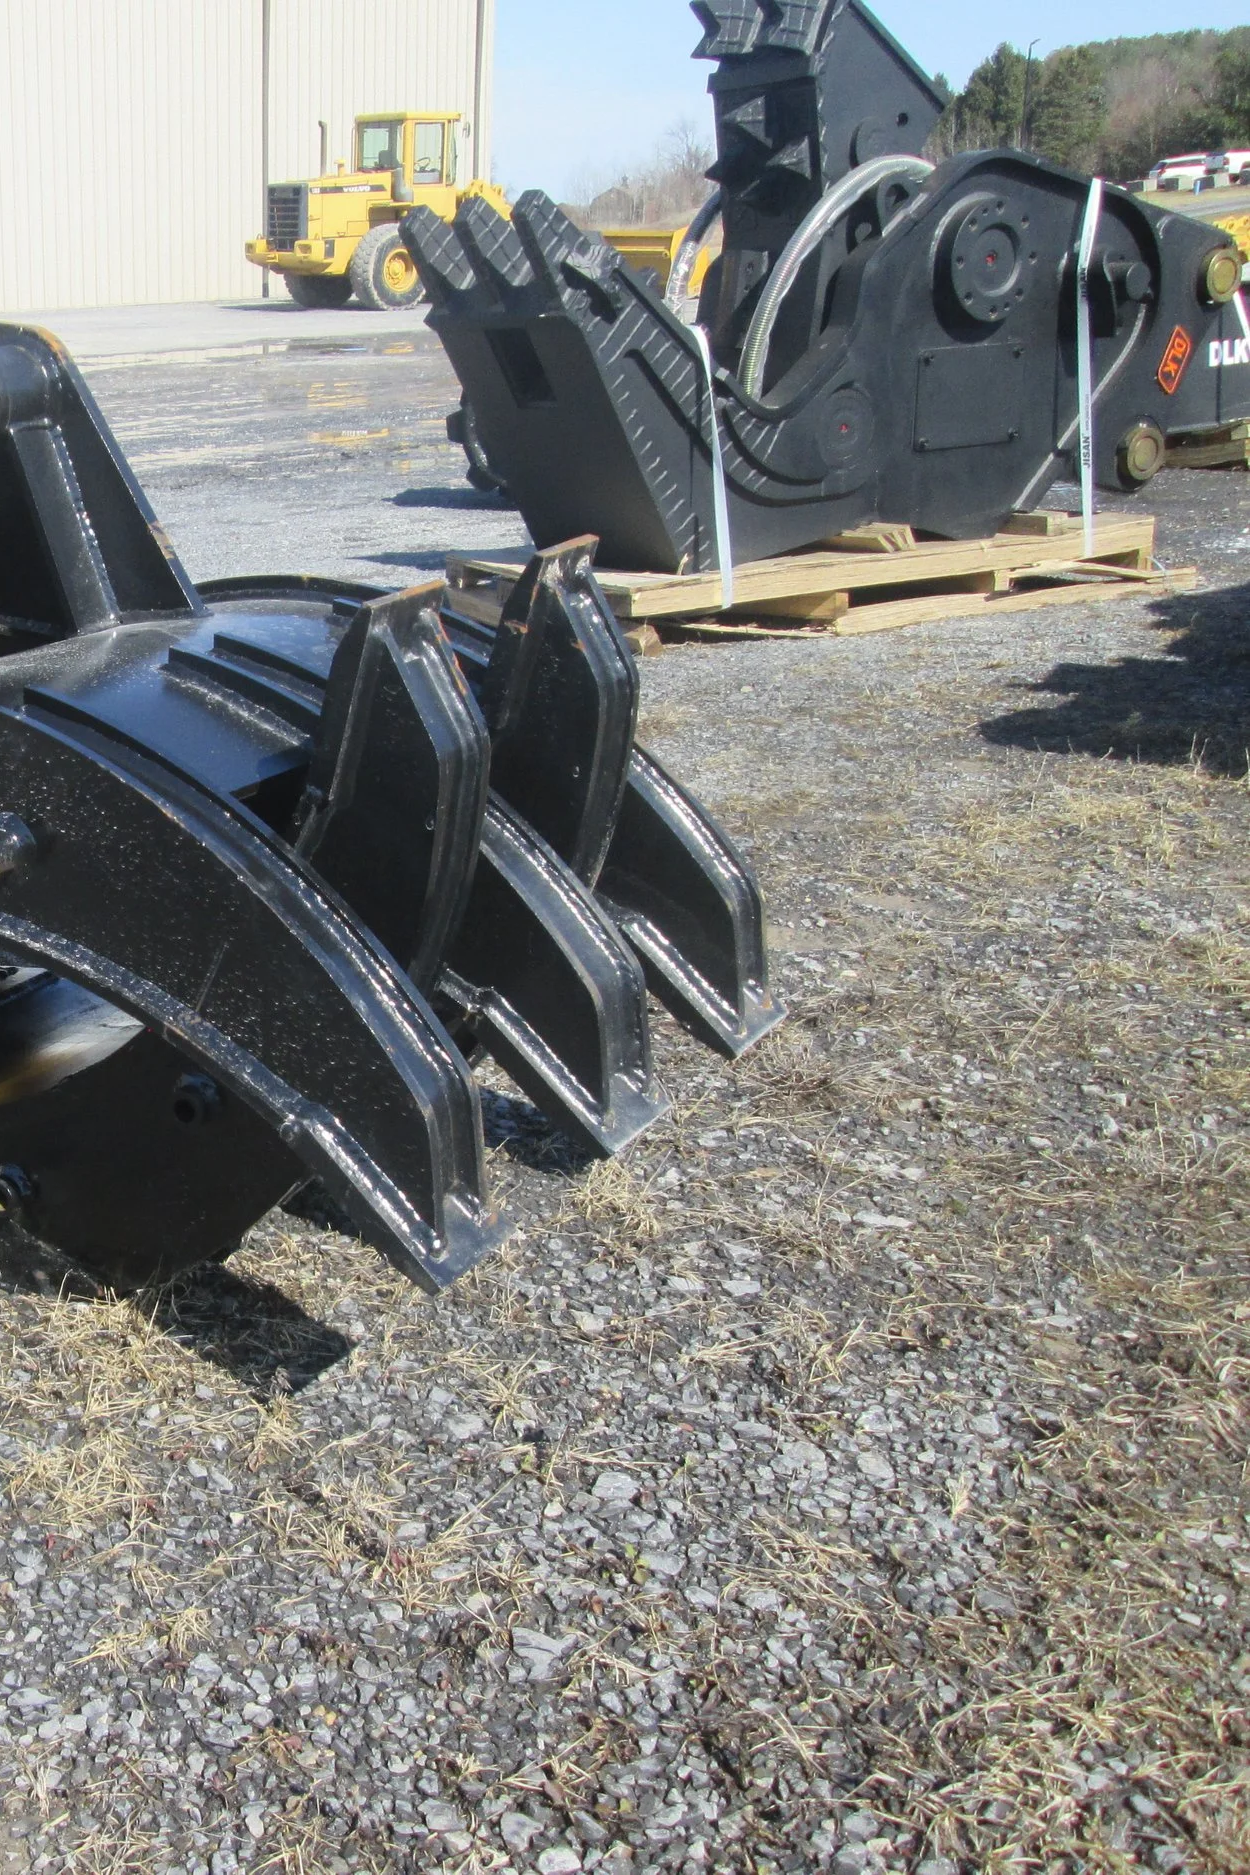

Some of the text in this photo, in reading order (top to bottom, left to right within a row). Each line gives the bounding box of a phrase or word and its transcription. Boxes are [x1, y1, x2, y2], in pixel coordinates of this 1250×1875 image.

[342, 185, 371, 193] VOLVO
[1161, 337, 1187, 378] DLK
[1082, 436, 1091, 469] JISAN
